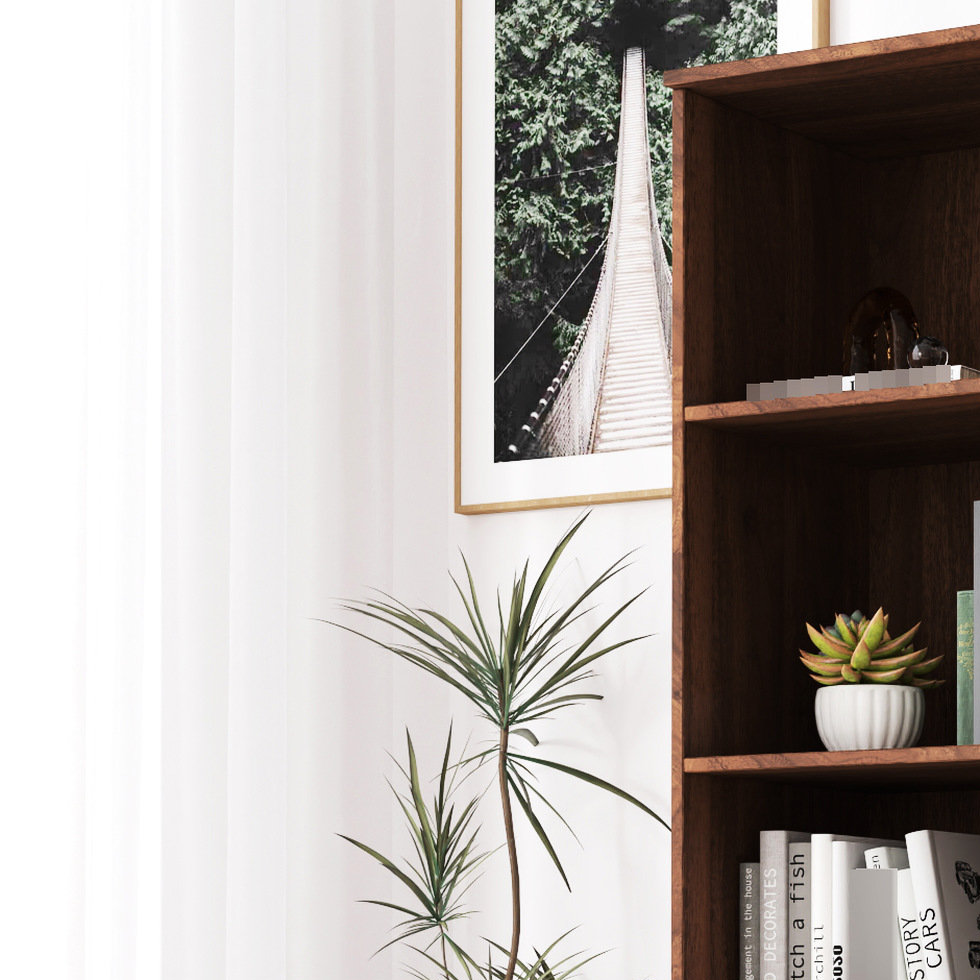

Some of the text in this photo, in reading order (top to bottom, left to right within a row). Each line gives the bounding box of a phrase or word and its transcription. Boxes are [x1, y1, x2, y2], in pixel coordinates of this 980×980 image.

[743, 867, 752, 898] house
[789, 854, 805, 904] fish
[743, 903, 752, 921] the
[763, 867, 778, 962] DECORATES
[793, 918, 805, 930] a
[743, 926, 752, 939] in
[919, 907, 943, 968] CARS
